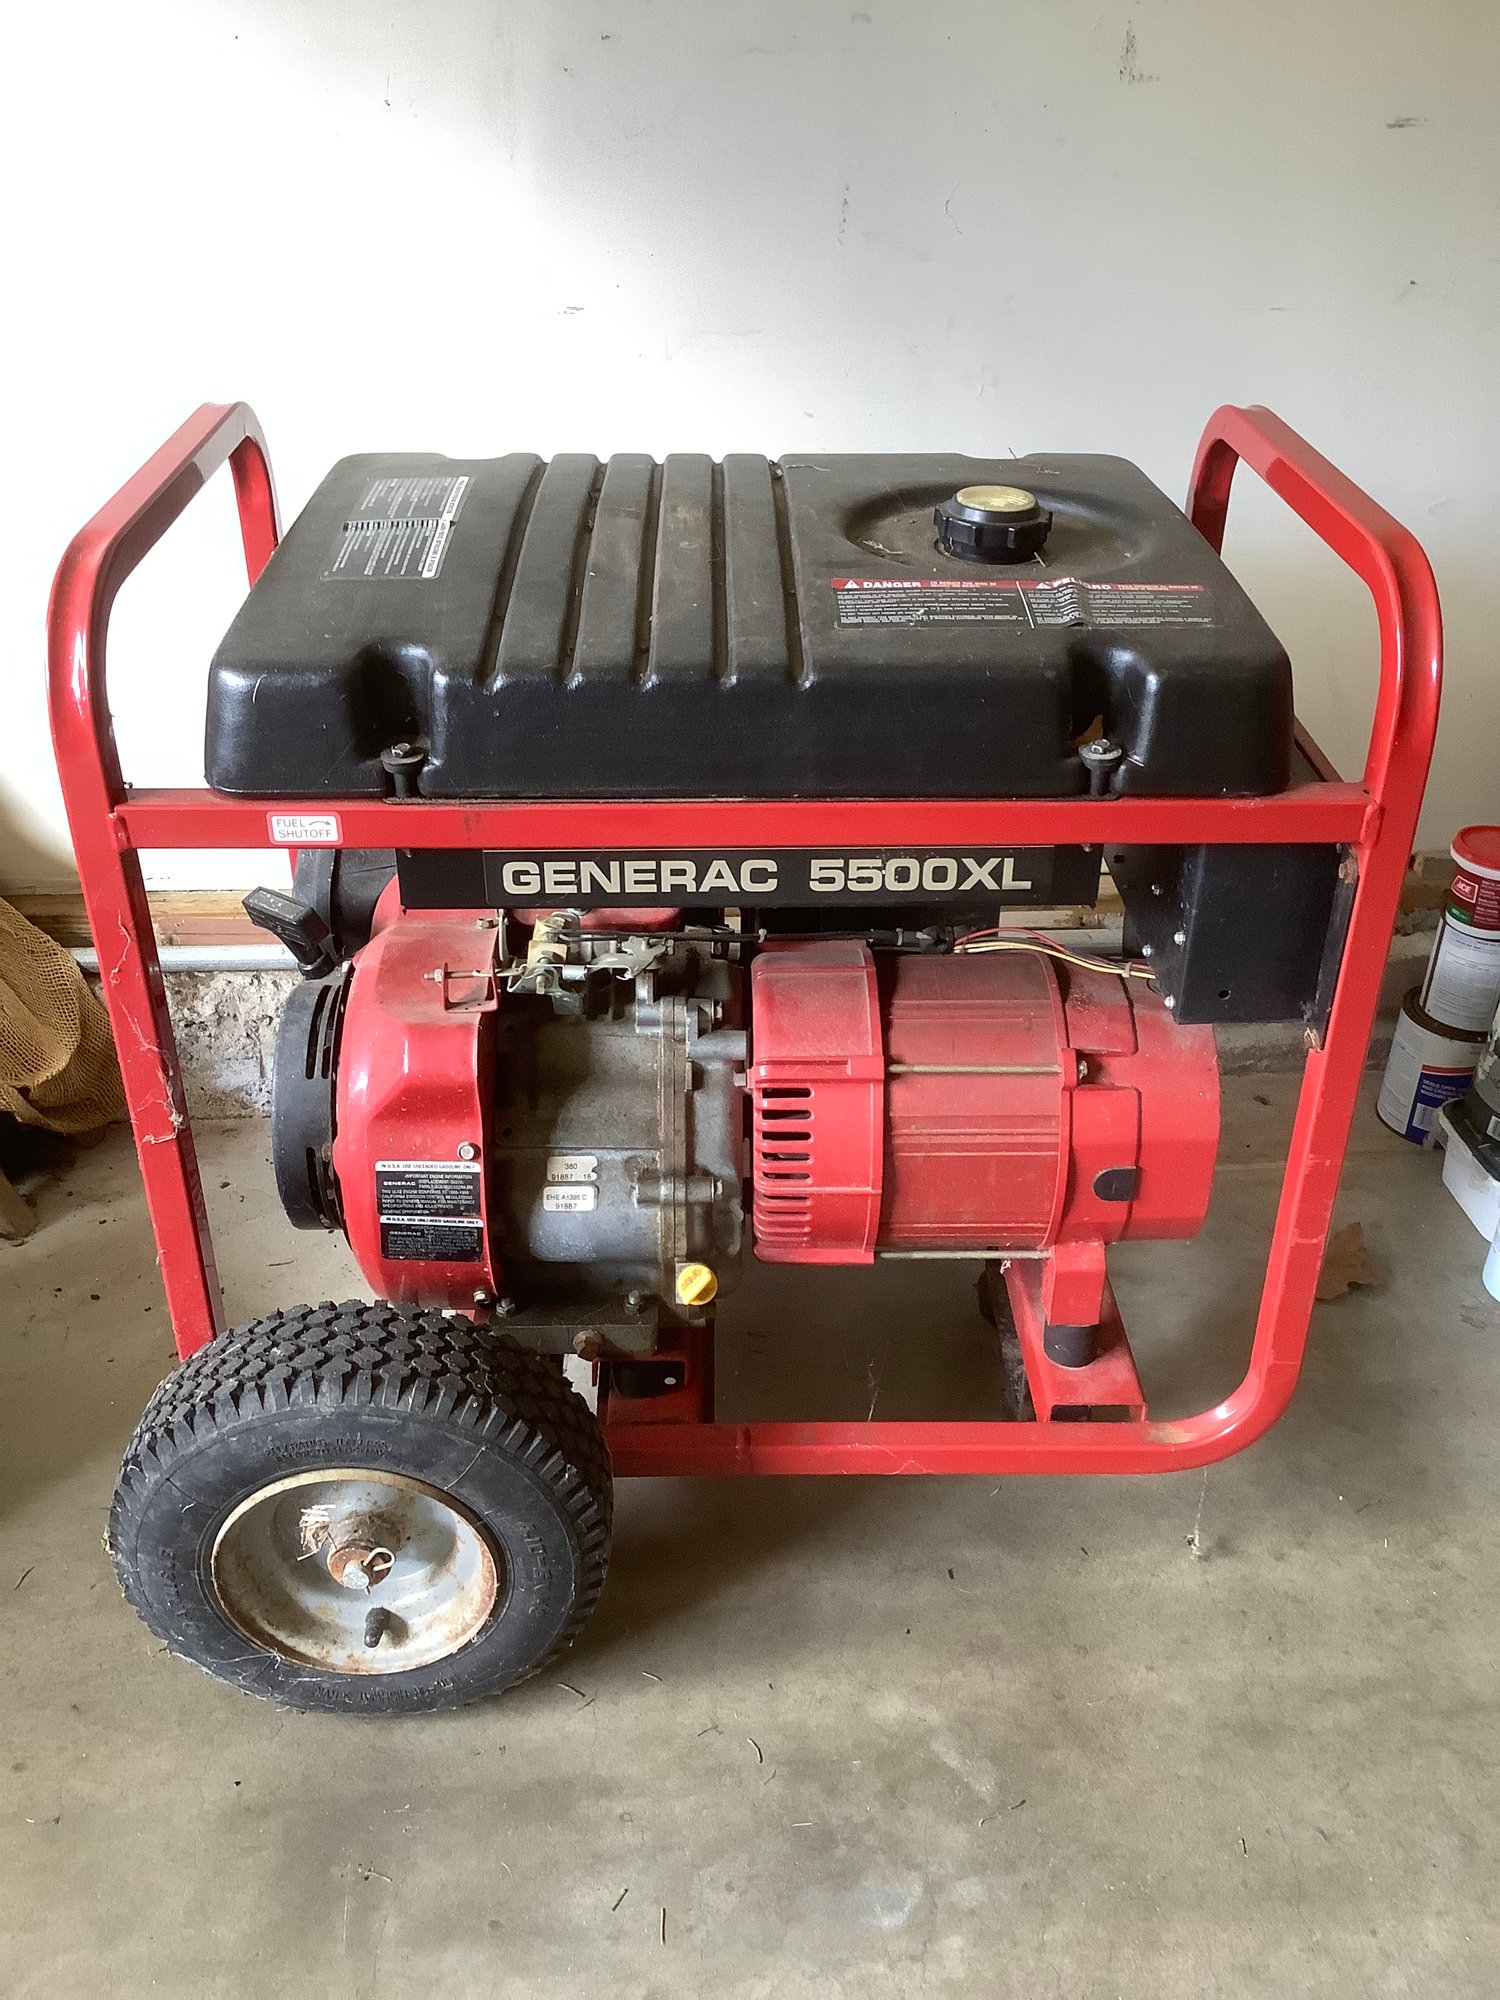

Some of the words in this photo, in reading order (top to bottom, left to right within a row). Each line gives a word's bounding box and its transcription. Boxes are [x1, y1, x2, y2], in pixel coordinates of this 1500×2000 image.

[863, 580, 922, 588] DANGER
[276, 819, 306, 828] FUEL
[278, 829, 332, 839] SHUTOFF
[501, 859, 778, 894] GENERAC
[809, 857, 1033, 892] 5500XL
[1456, 881, 1472, 894] ACE
